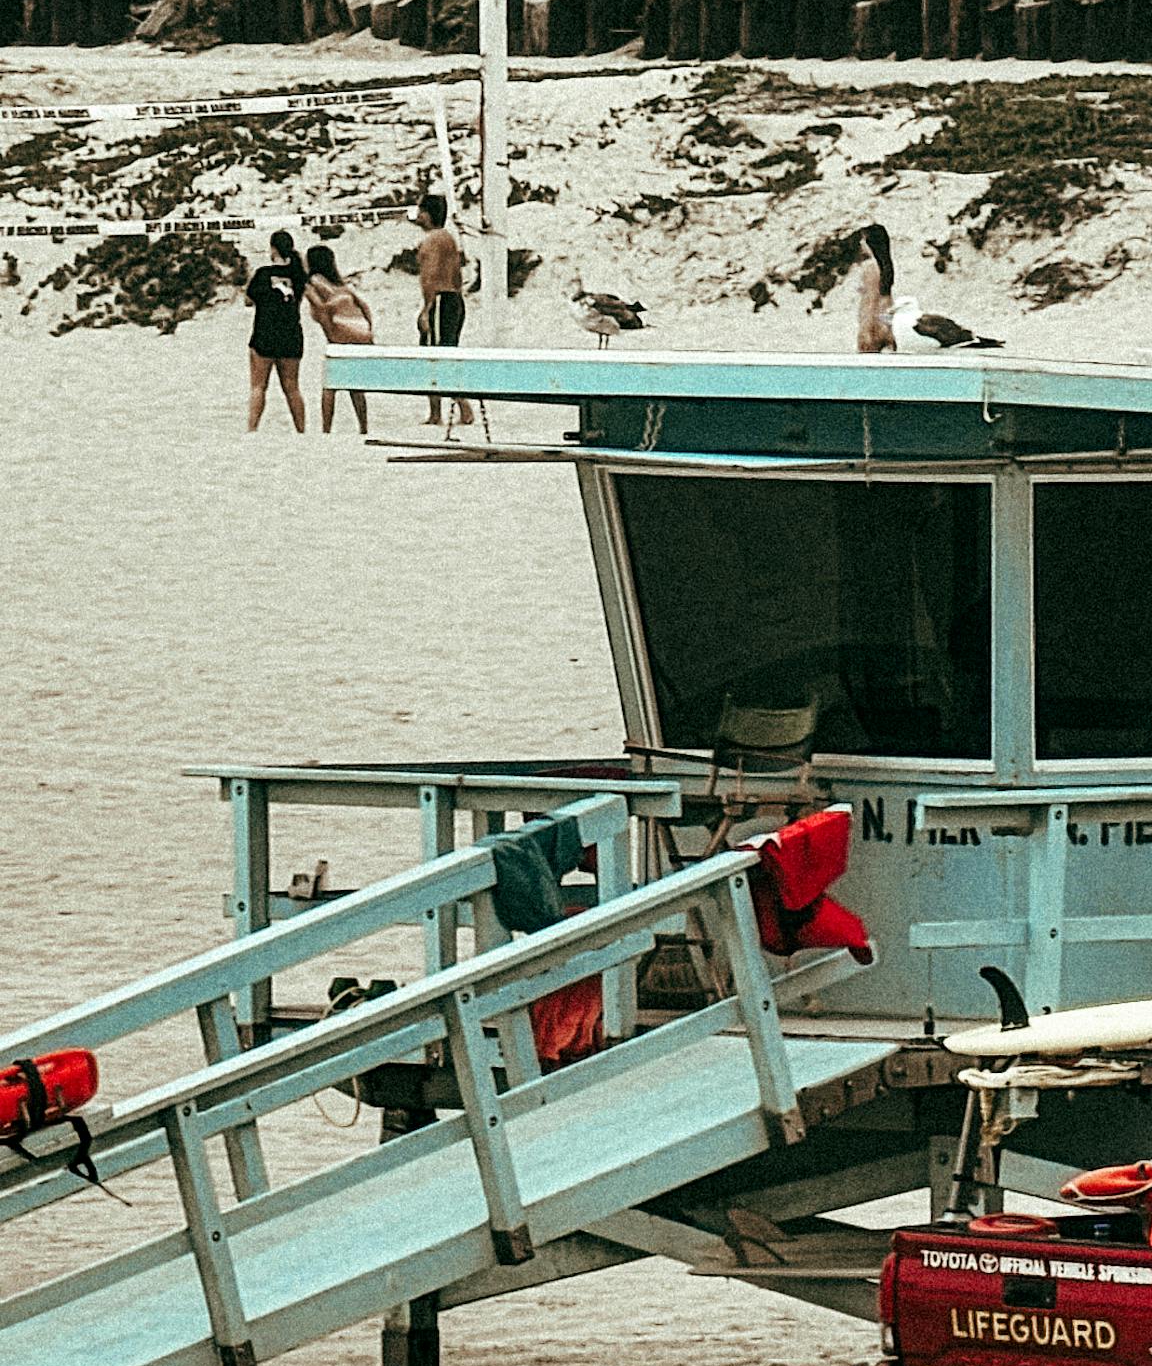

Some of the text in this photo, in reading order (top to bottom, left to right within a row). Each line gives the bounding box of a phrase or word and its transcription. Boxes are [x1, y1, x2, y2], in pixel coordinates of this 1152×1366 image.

[920, 1249, 978, 1271] TOYOTA
[1049, 1260, 1096, 1281] VEHICLE
[950, 1308, 1117, 1350] LIFEGUARD
